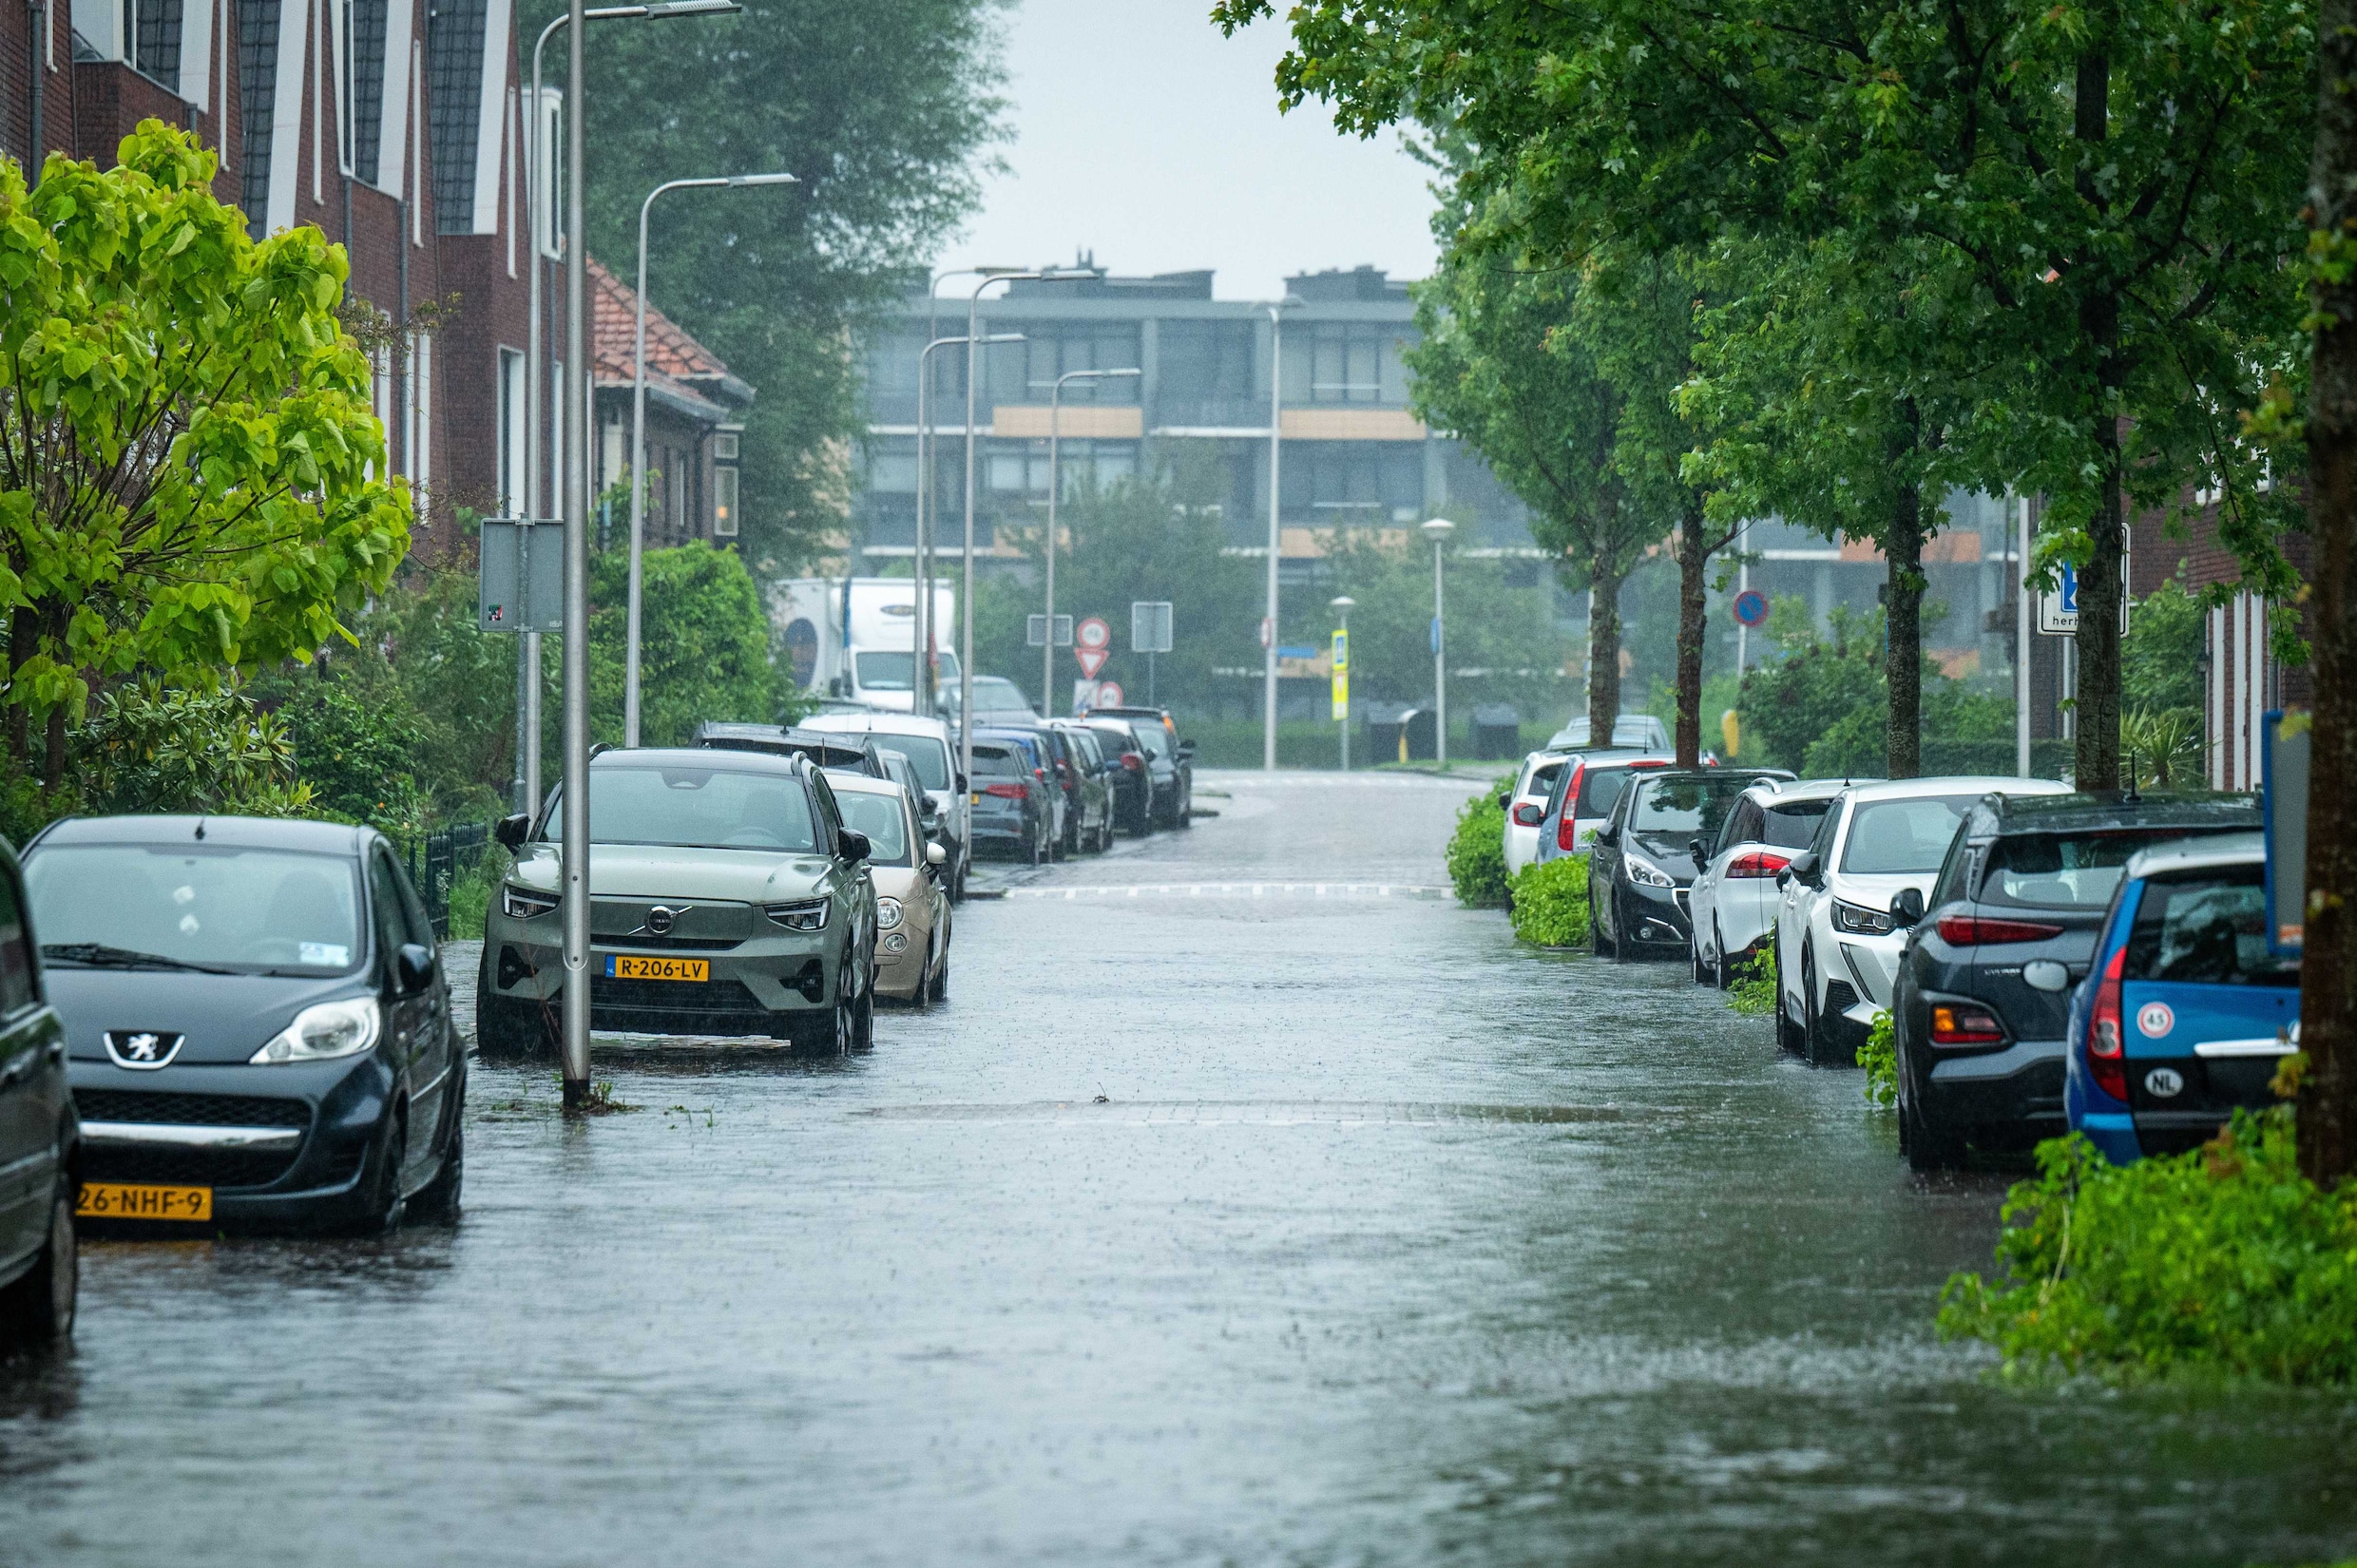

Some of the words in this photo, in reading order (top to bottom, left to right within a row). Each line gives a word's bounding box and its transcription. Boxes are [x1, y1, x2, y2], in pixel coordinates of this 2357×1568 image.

[2052, 616, 2079, 626] herh
[622, 959, 702, 978] R-206-LV
[2152, 1073, 2175, 1092] NL
[77, 1189, 203, 1215] 26-NHF-9
